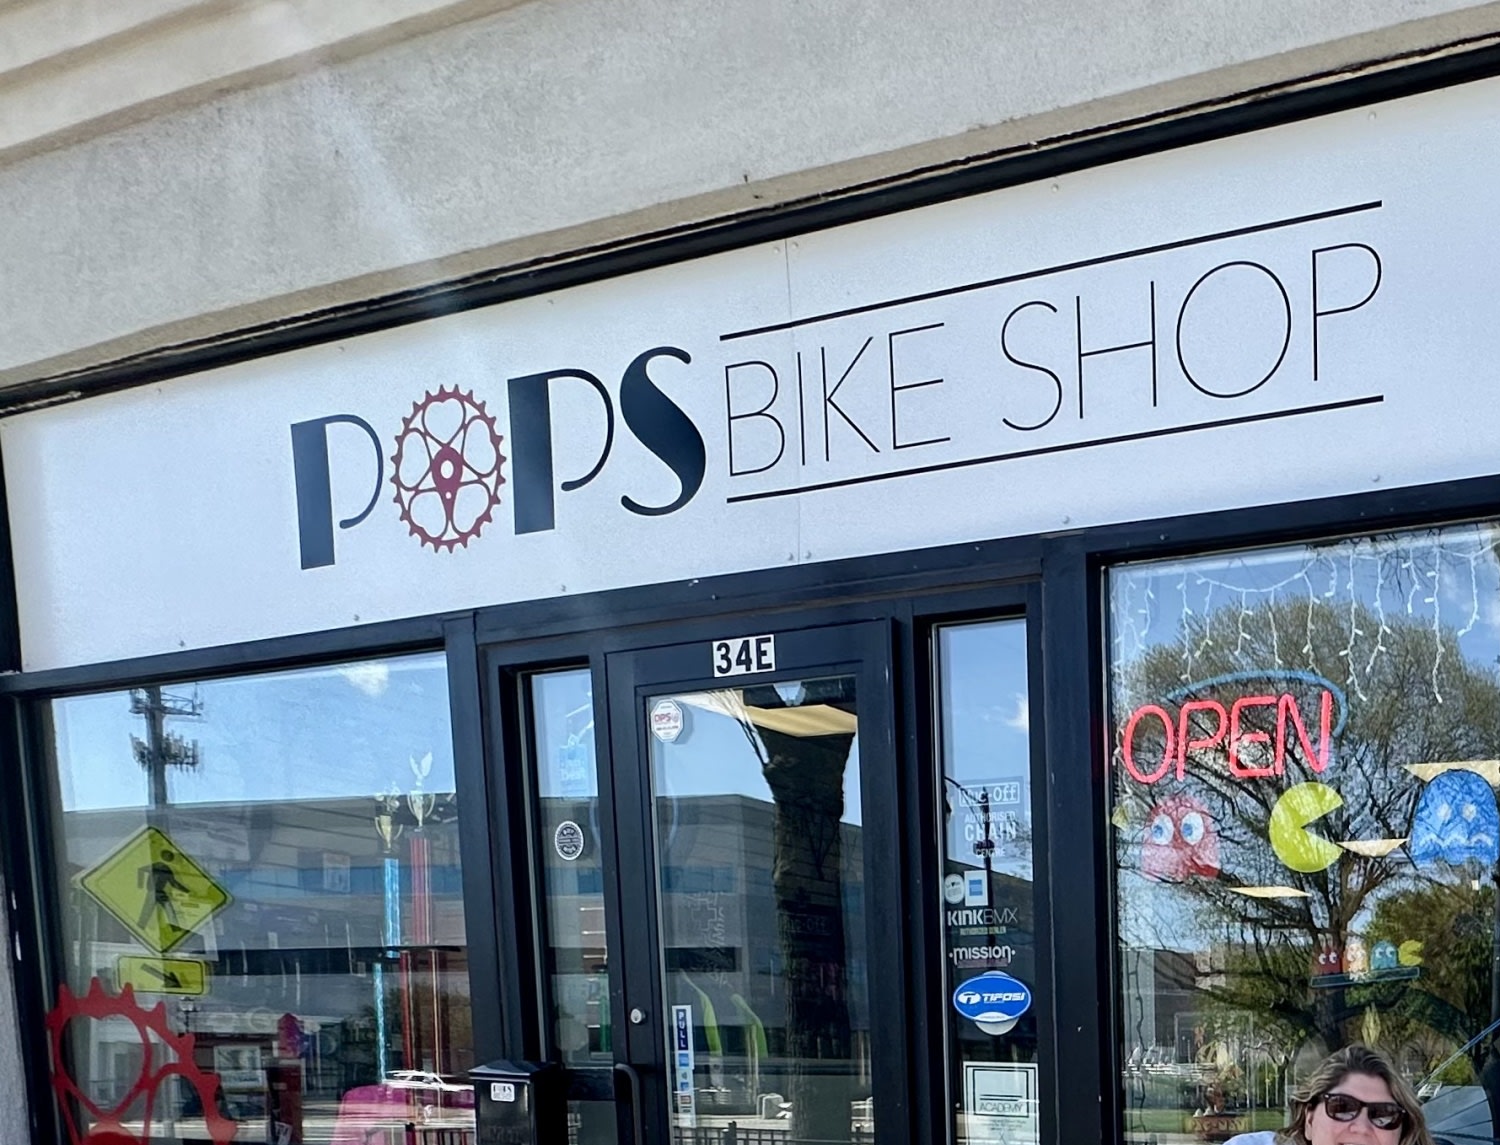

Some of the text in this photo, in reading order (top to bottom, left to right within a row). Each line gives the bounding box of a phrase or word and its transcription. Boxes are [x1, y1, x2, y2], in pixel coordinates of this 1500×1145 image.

[724, 321, 952, 478] BIKE
[1000, 242, 1383, 432] SHOP
[716, 636, 773, 675] 34E
[1123, 690, 1333, 784] OPEN
[964, 822, 1017, 842] CHAIN
[982, 992, 1026, 1002] TIFOSI
[678, 1011, 687, 1048] PULL
[980, 1102, 1023, 1114] ACADEMY
